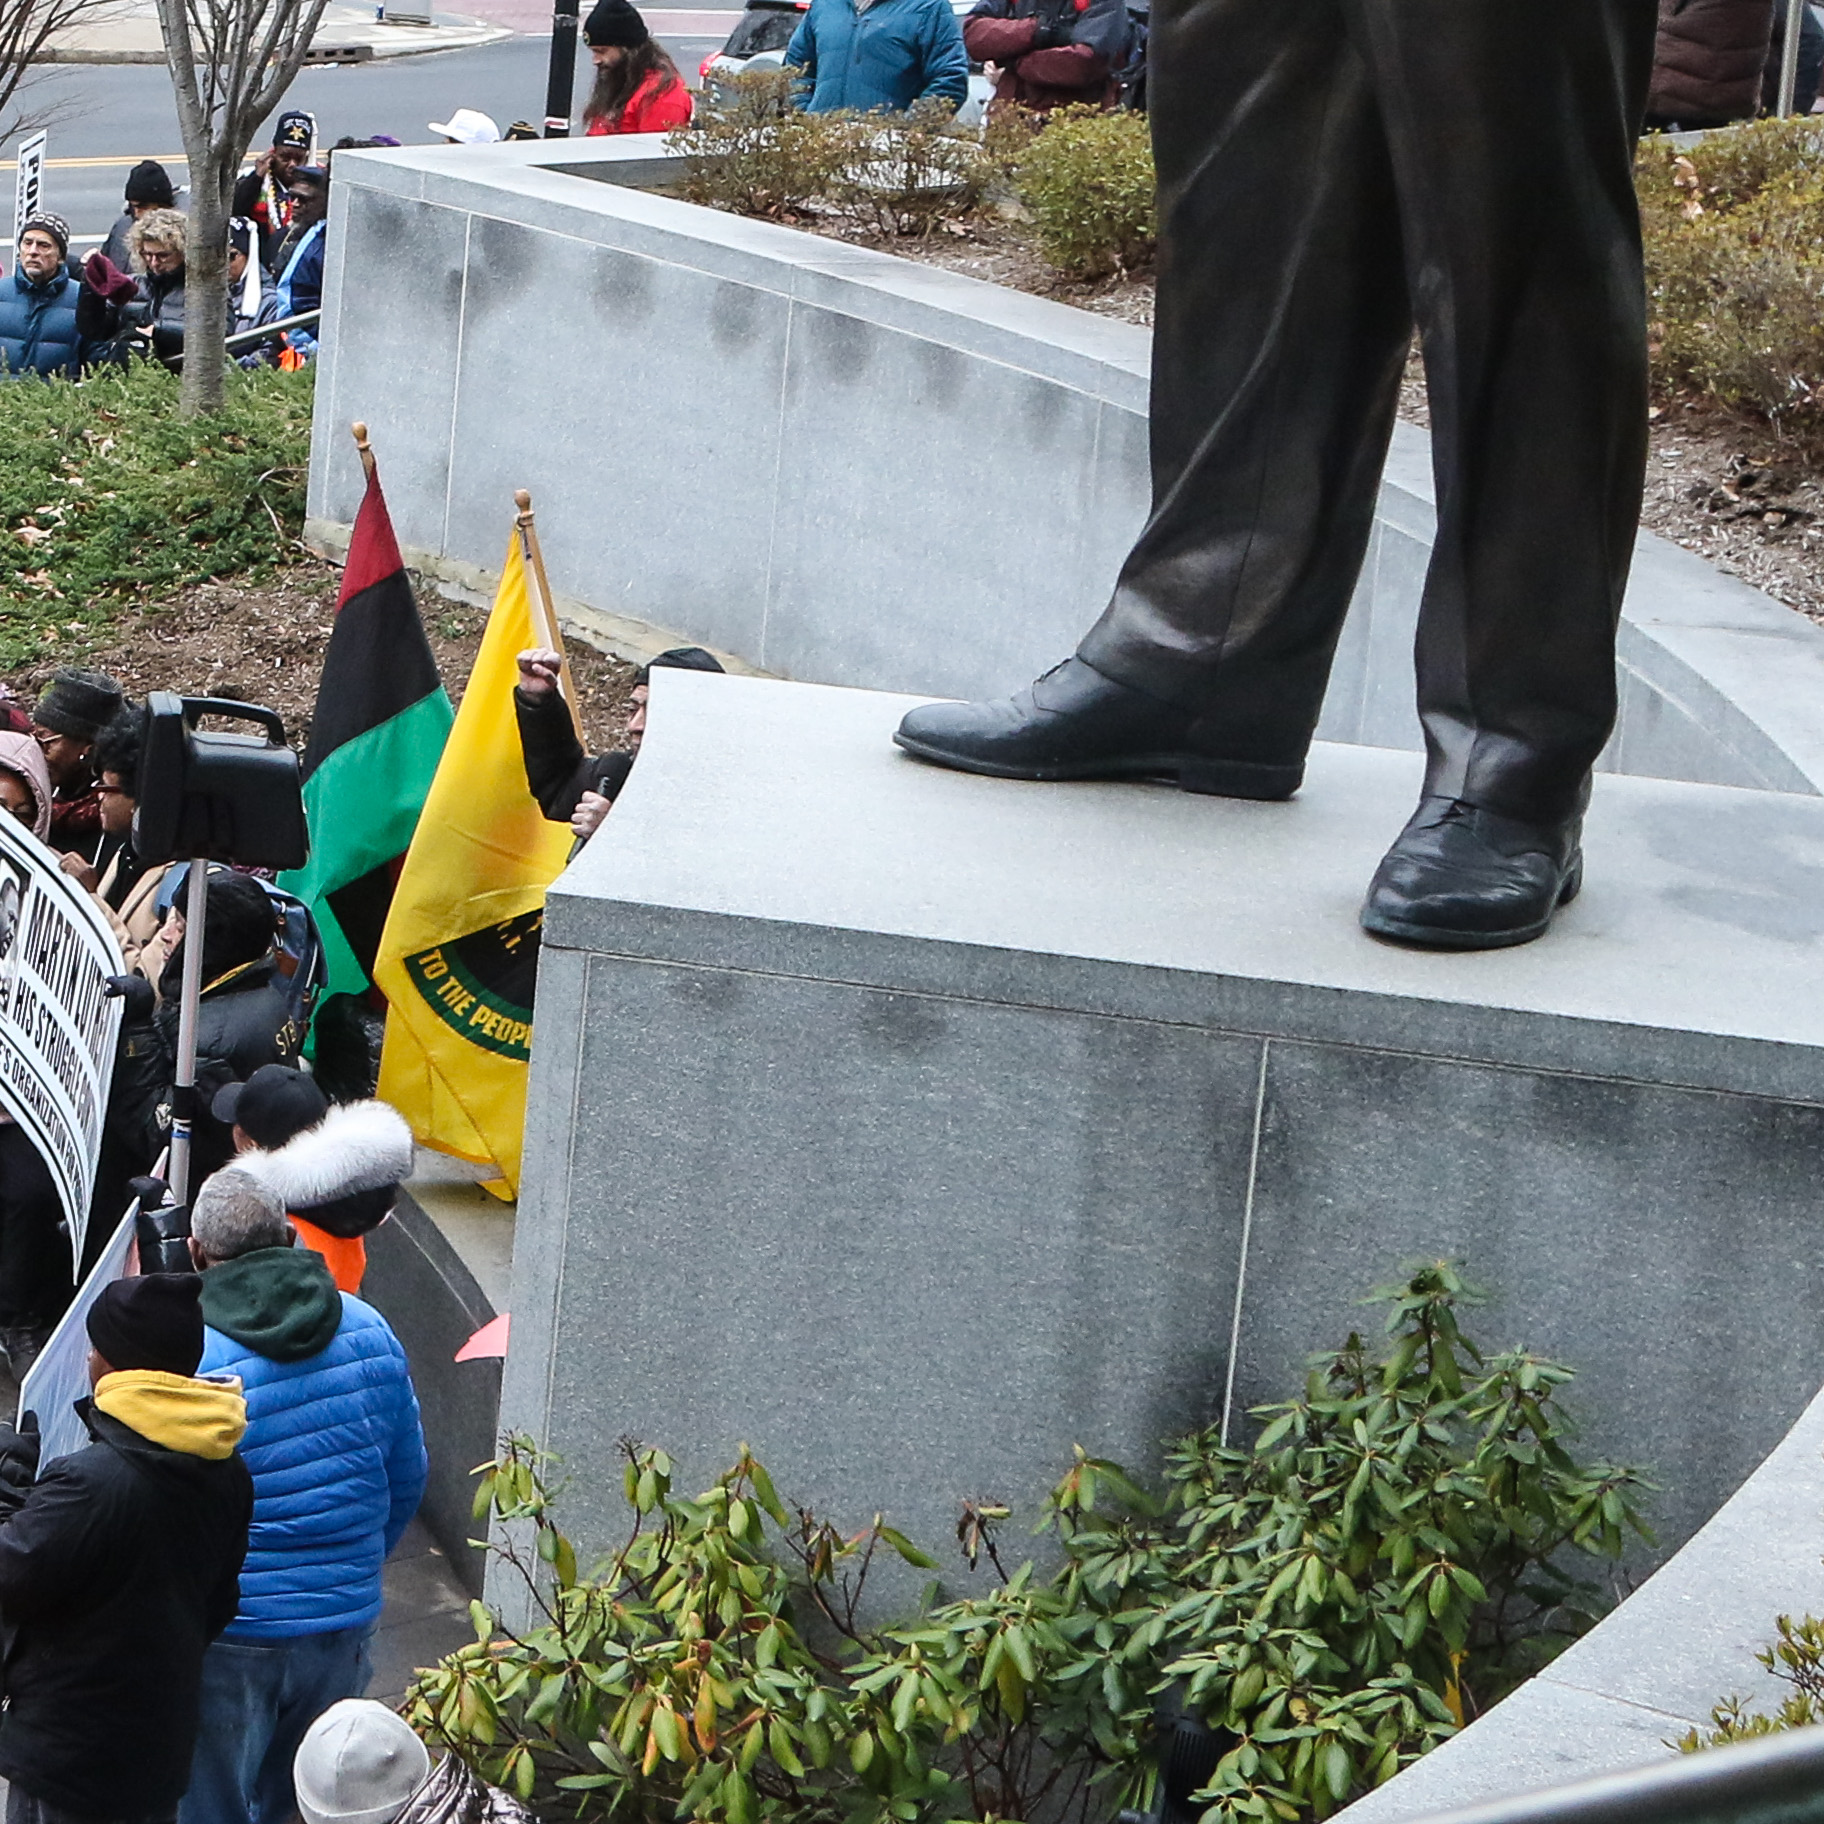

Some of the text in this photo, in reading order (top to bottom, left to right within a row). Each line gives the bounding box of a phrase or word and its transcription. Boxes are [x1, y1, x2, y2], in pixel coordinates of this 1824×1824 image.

[24, 885, 85, 1017] MARTIN
[418, 949, 448, 980] TO
[436, 976, 477, 1017] THE
[13, 977, 83, 1110] HIS STRUGGLE
[11, 1057, 67, 1160] ORGANIZATION
